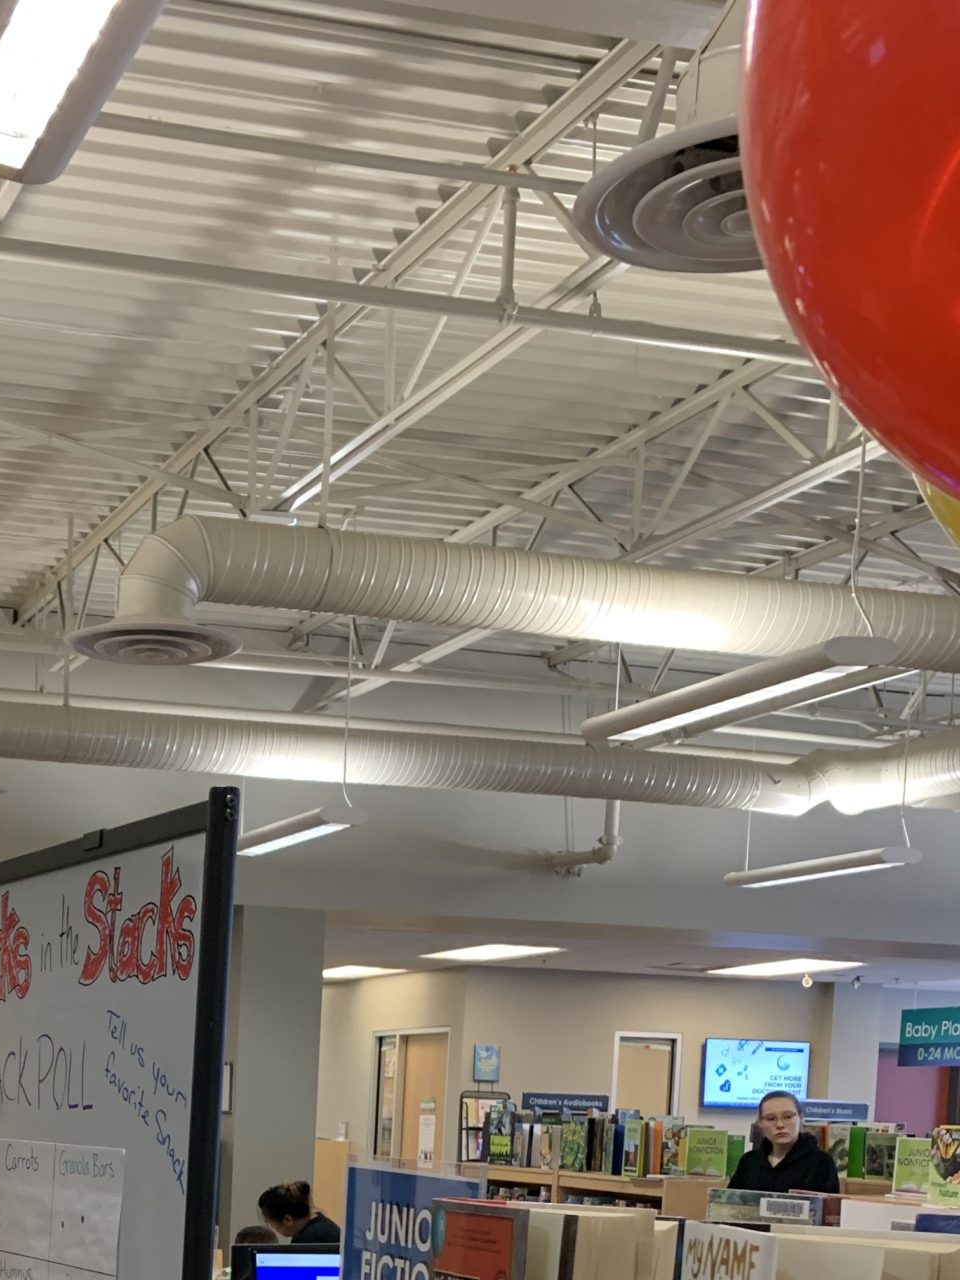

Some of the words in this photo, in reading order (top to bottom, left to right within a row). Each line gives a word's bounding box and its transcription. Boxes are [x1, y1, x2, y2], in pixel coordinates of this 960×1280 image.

[40, 934, 52, 972] in
[61, 895, 80, 973] the
[78, 845, 197, 986] Stacks
[107, 1010, 127, 1048] Tell
[130, 1044, 145, 1067] us
[905, 1022, 938, 1040] Baby
[917, 1047, 941, 1061] 0-24
[37, 1033, 93, 1111] POLL
[529, 1096, 562, 1106] Children's
[563, 1098, 603, 1108] Audiobooks
[5, 1144, 40, 1172] Carrots
[897, 1157, 930, 1167] NONFICT
[908, 1147, 930, 1157] JUNIO
[365, 1201, 432, 1252] JUNIO
